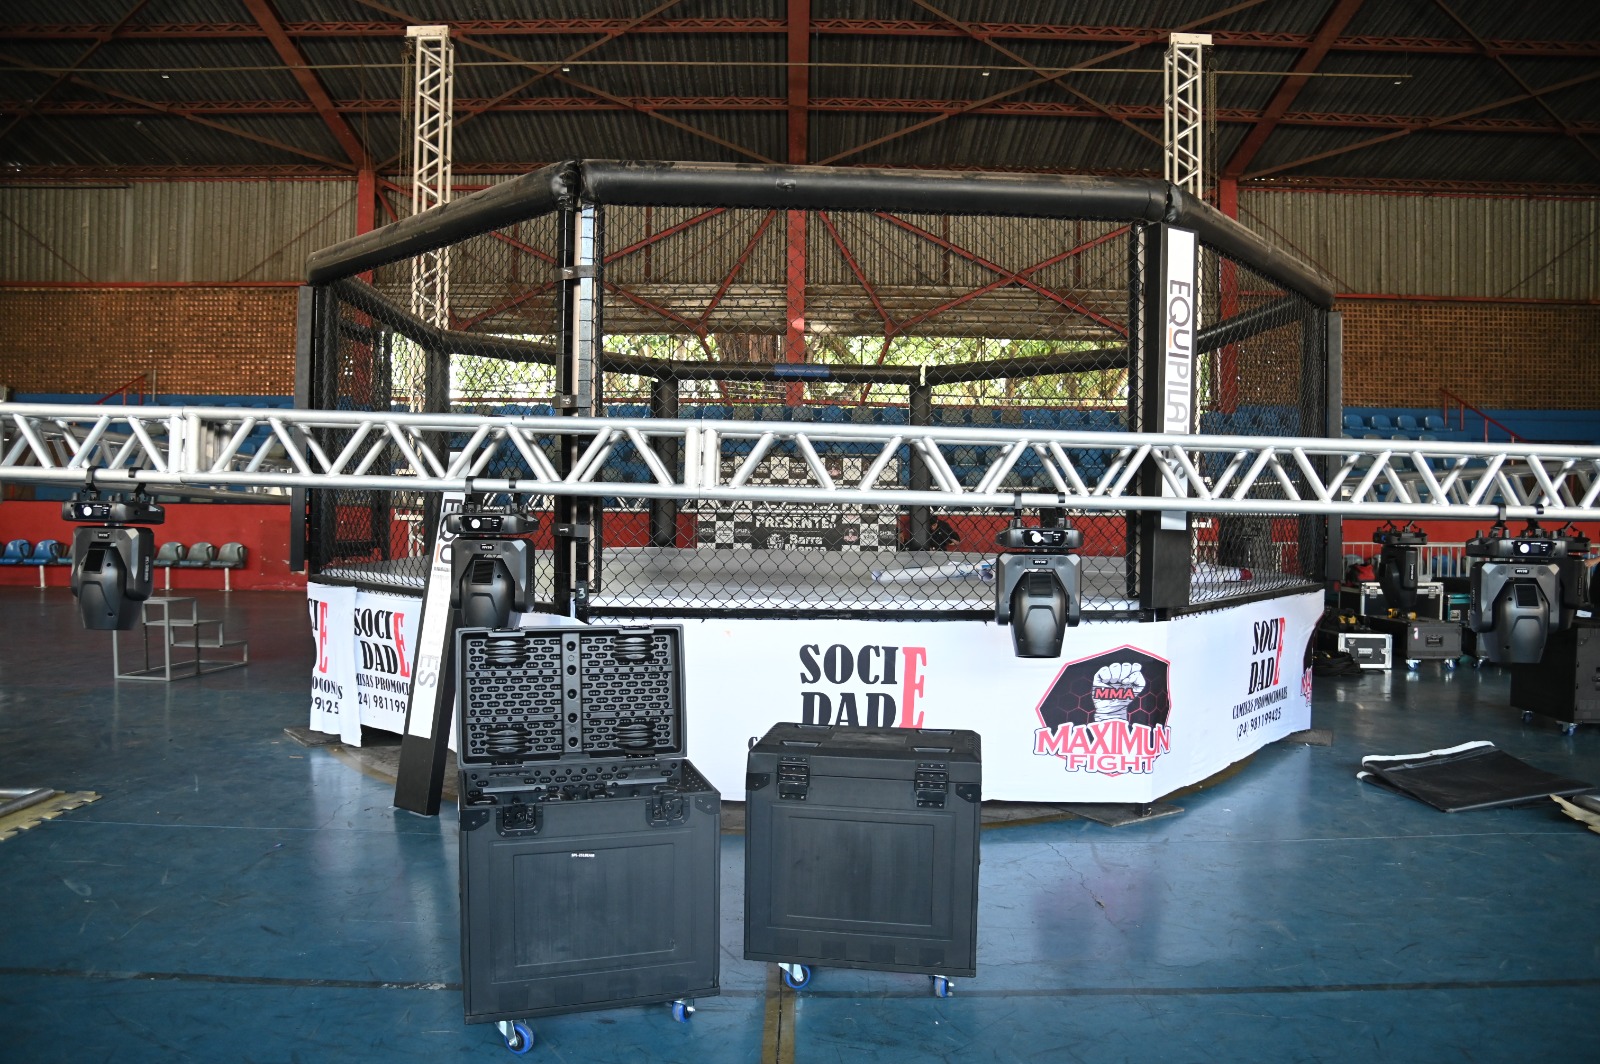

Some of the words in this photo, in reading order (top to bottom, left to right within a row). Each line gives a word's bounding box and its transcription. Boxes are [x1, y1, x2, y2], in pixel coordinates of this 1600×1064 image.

[755, 515, 837, 529] PRESENTE!
[1095, 688, 1135, 699] MMA
[1036, 720, 1170, 756] MAXIMUN
[1068, 754, 1156, 771] FIGHT
